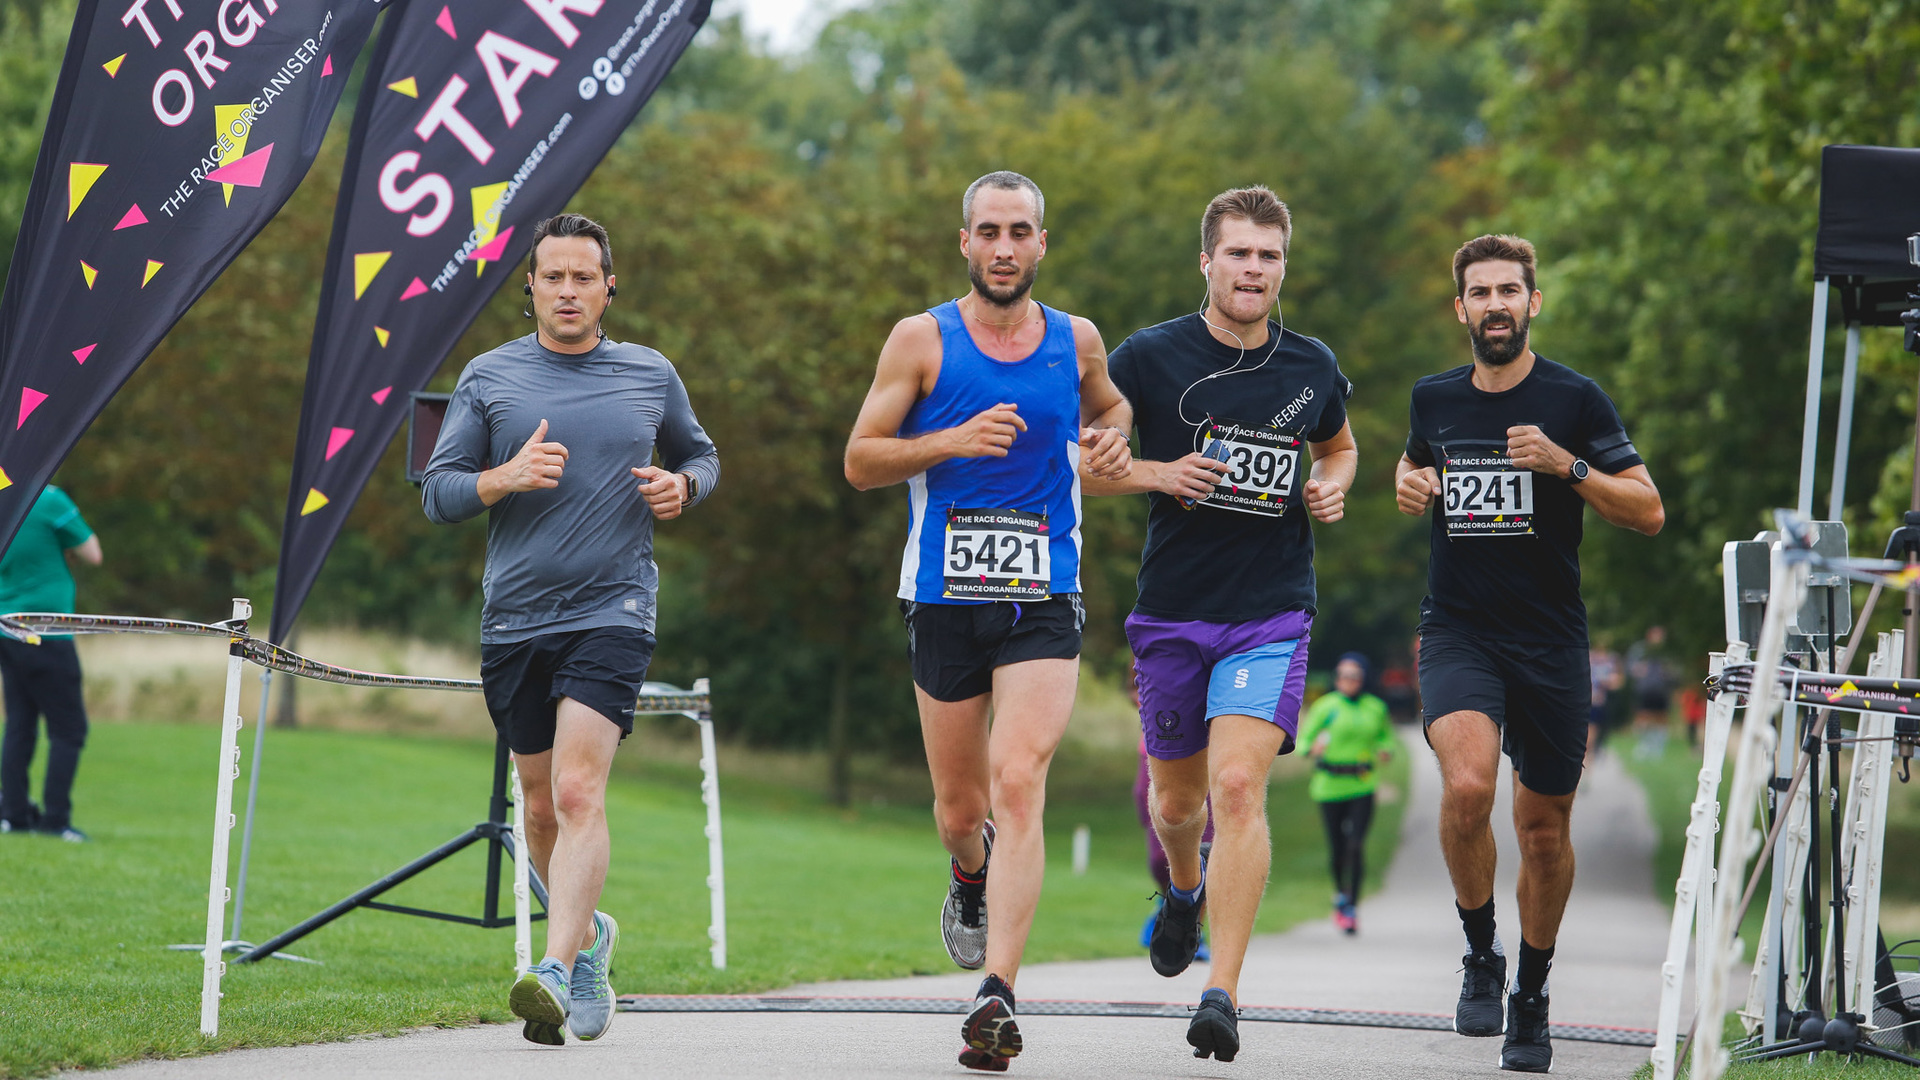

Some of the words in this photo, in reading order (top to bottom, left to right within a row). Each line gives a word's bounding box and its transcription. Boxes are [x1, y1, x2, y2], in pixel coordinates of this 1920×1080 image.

[160, 180, 193, 218] THE
[190, 133, 234, 187] RACE
[229, 10, 333, 138] ORGANISER.com
[431, 259, 459, 293] THE
[454, 221, 489, 266] RACE
[485, 112, 573, 224] ORGANISER.com
[1270, 386, 1314, 428] EERING
[1256, 432, 1295, 443] ORGANISER
[1218, 447, 1292, 491] 392
[1446, 475, 1522, 511] 5241
[957, 515, 973, 523] THE
[974, 515, 995, 523] RACE
[996, 516, 1040, 528] ORGANISER
[950, 534, 1040, 575] 5421
[948, 584, 1046, 595] THERACEORGANISER.COM
[1801, 684, 1819, 693] THE
[1820, 686, 1844, 696] RACE
[1846, 688, 1912, 703] ORGANISER.com
